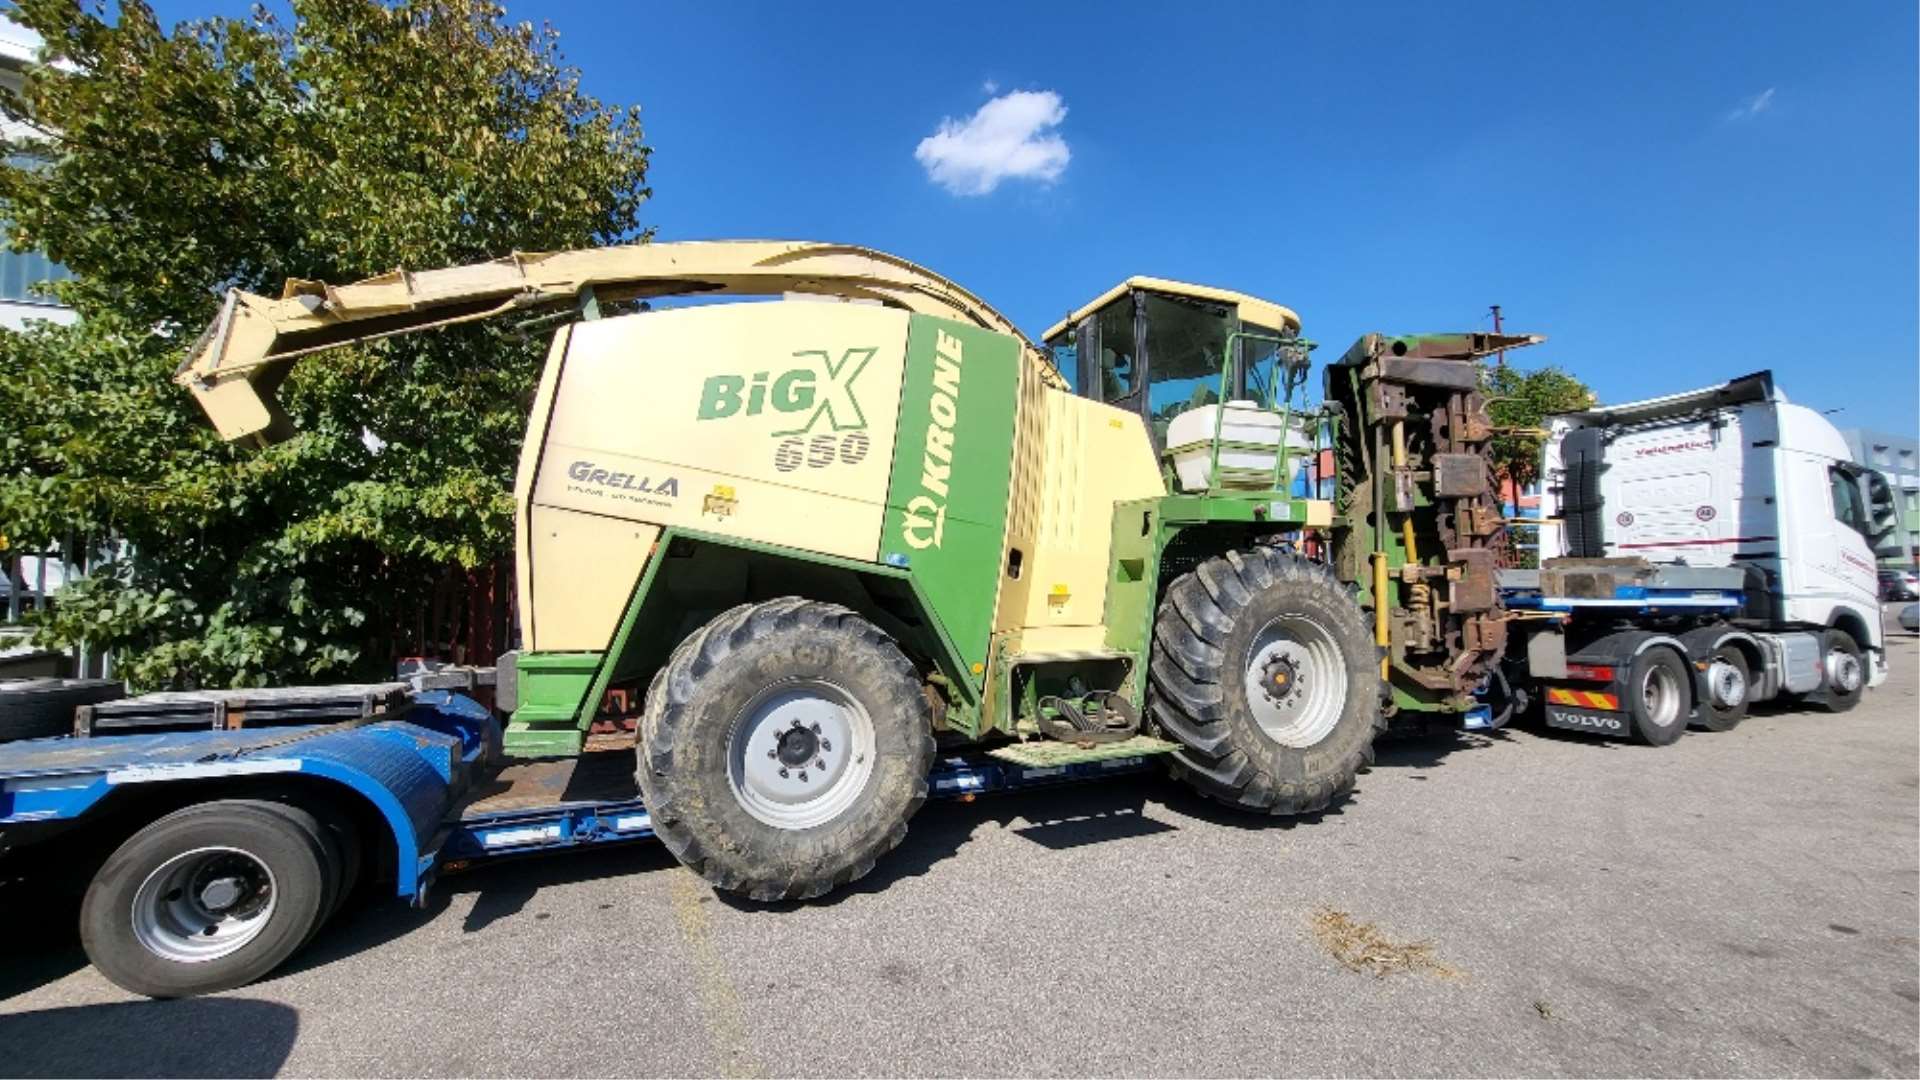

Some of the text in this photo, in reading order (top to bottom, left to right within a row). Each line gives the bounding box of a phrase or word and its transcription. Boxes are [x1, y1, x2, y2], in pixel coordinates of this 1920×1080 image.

[921, 328, 963, 498] KRONE
[774, 431, 870, 472] 650
[1552, 712, 1621, 729] VOLVO
